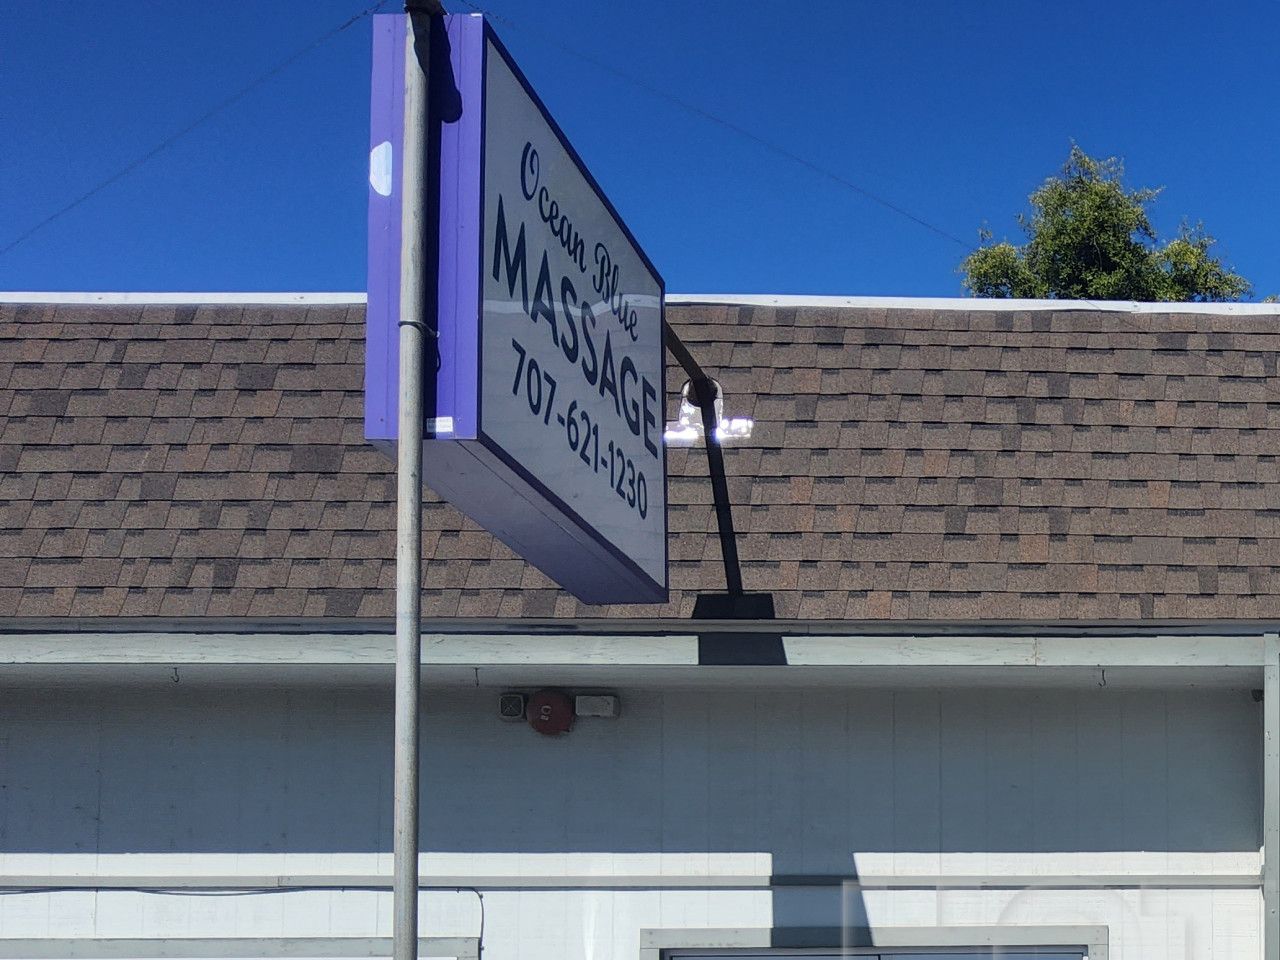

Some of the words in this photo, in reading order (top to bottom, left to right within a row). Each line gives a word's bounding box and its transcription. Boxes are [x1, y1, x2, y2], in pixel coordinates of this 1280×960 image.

[492, 192, 659, 460] MASSAGE
[520, 141, 587, 273] Ocean
[592, 242, 639, 342] Blue
[511, 337, 649, 520] 707-621-1230
